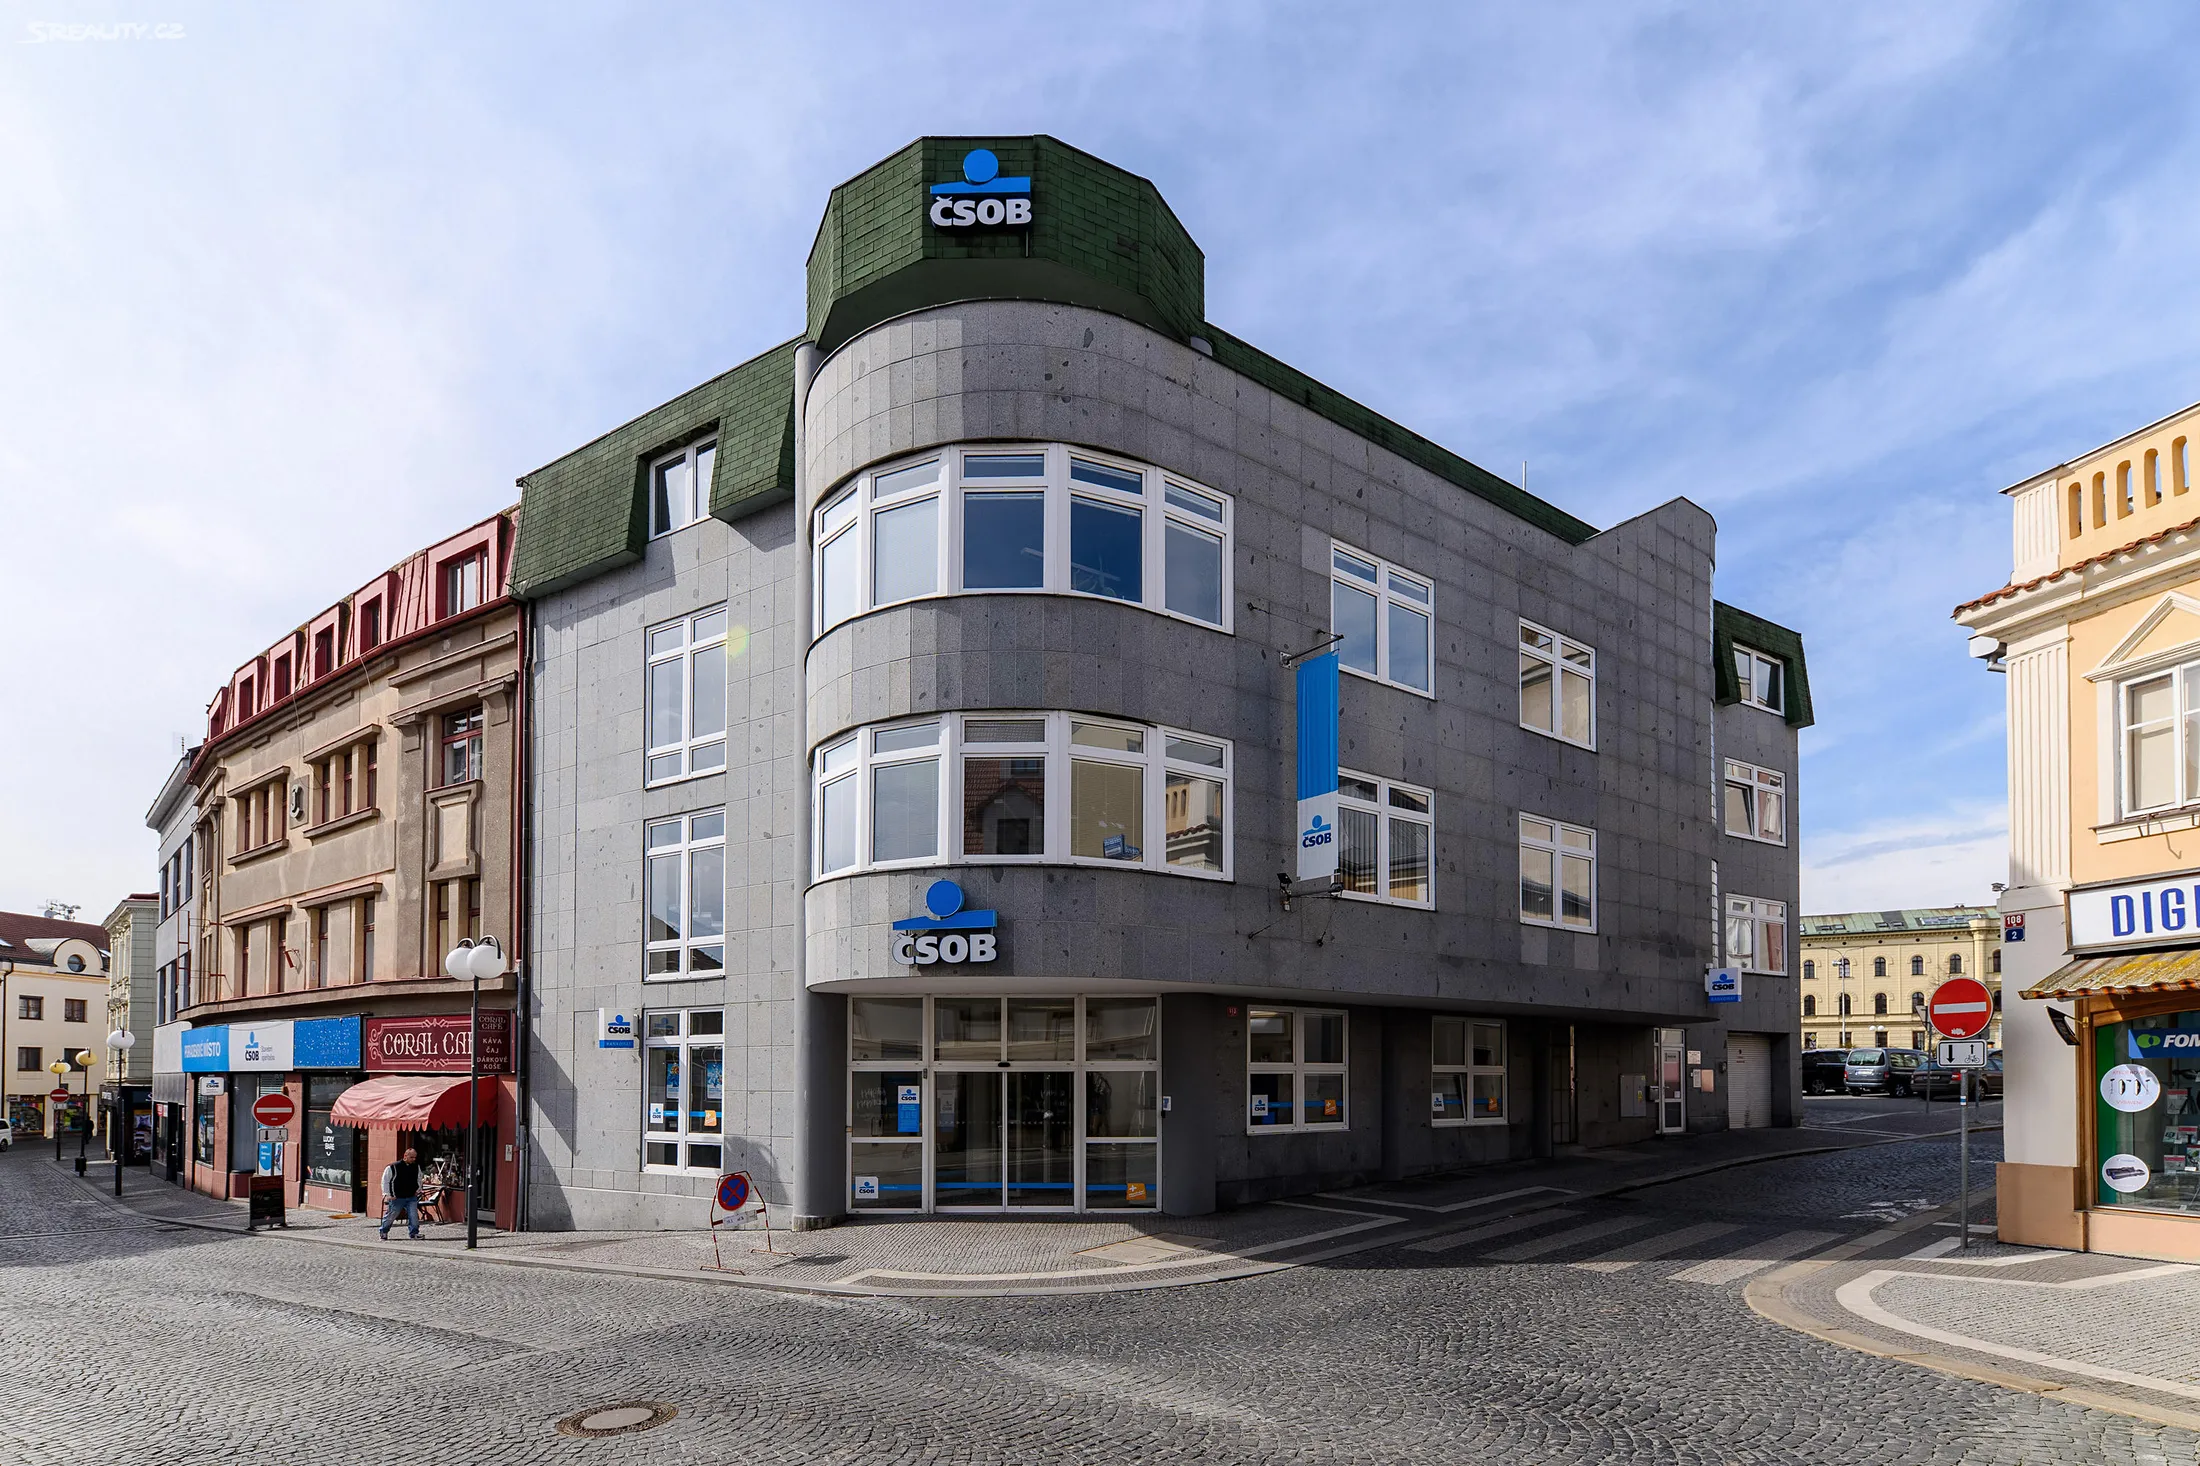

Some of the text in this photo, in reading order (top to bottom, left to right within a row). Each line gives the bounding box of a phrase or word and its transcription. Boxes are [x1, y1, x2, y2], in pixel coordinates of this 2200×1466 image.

[929, 196, 1032, 227] ČSOB
[1302, 832, 1332, 848] ČSOB
[2006, 915, 2022, 925] 108
[2011, 931, 2018, 940] 2
[892, 932, 997, 965] ČSOB
[1712, 983, 1735, 991] ČSOB
[608, 1026, 631, 1035] ČSOB
[383, 1031, 473, 1057] CORAL CAF
[245, 1049, 259, 1061] ČSOB
[486, 1046, 499, 1054] ČAJ
